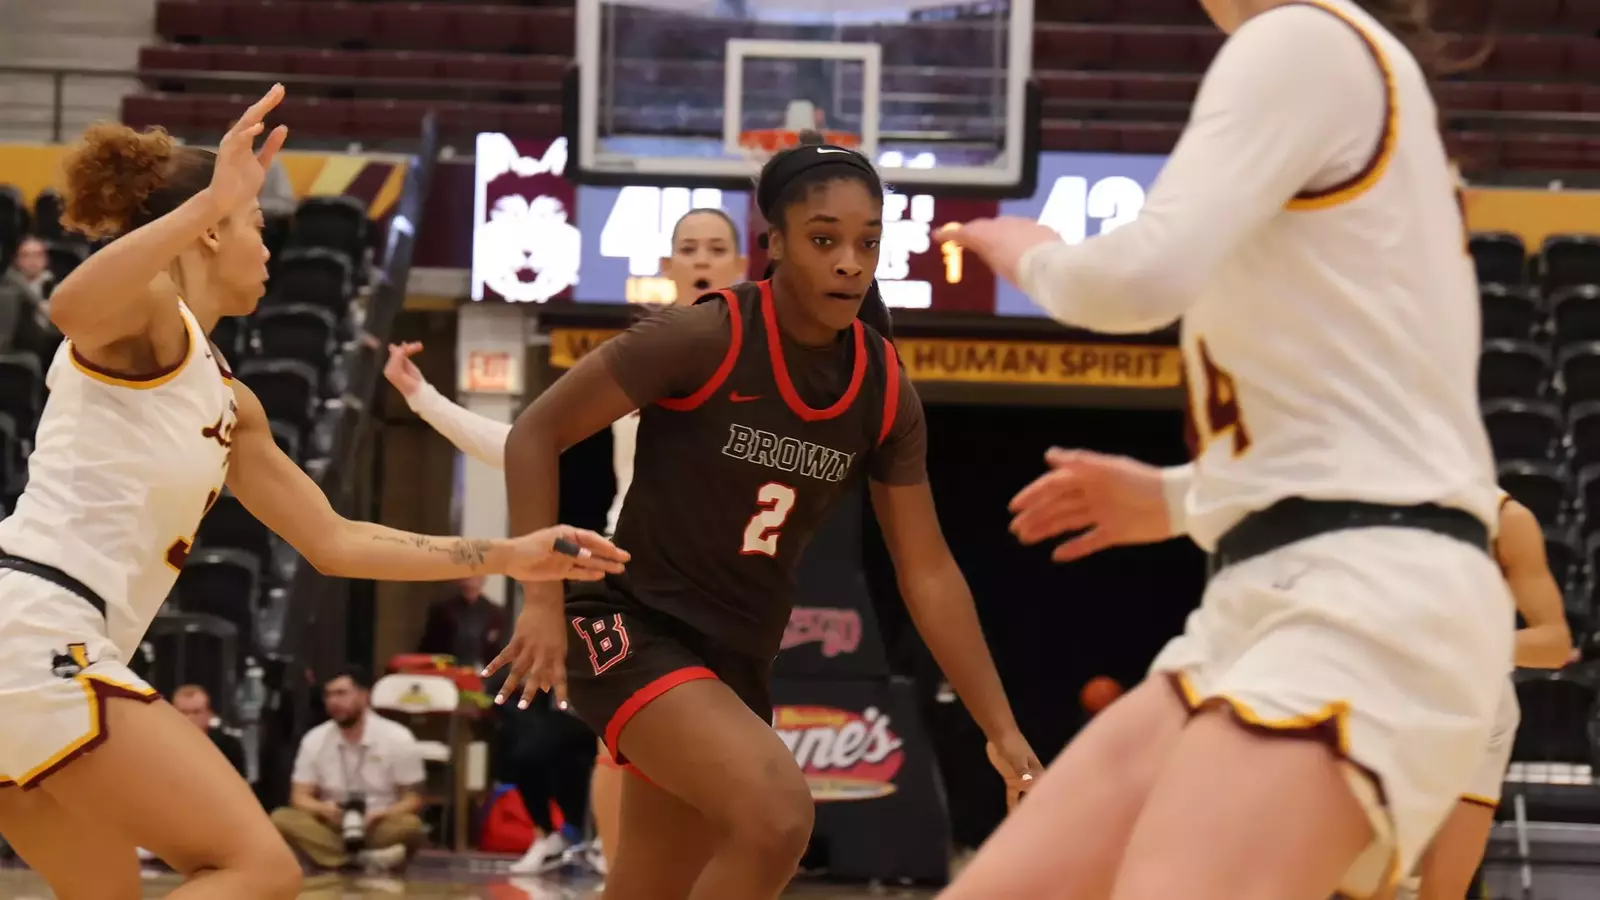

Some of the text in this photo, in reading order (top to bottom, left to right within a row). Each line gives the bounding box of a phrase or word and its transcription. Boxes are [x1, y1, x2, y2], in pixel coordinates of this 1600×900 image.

[913, 345, 1163, 379] HUMAN SPIRIT
[722, 423, 857, 482] BROWN
[739, 481, 798, 558] 2
[572, 613, 630, 676] B
